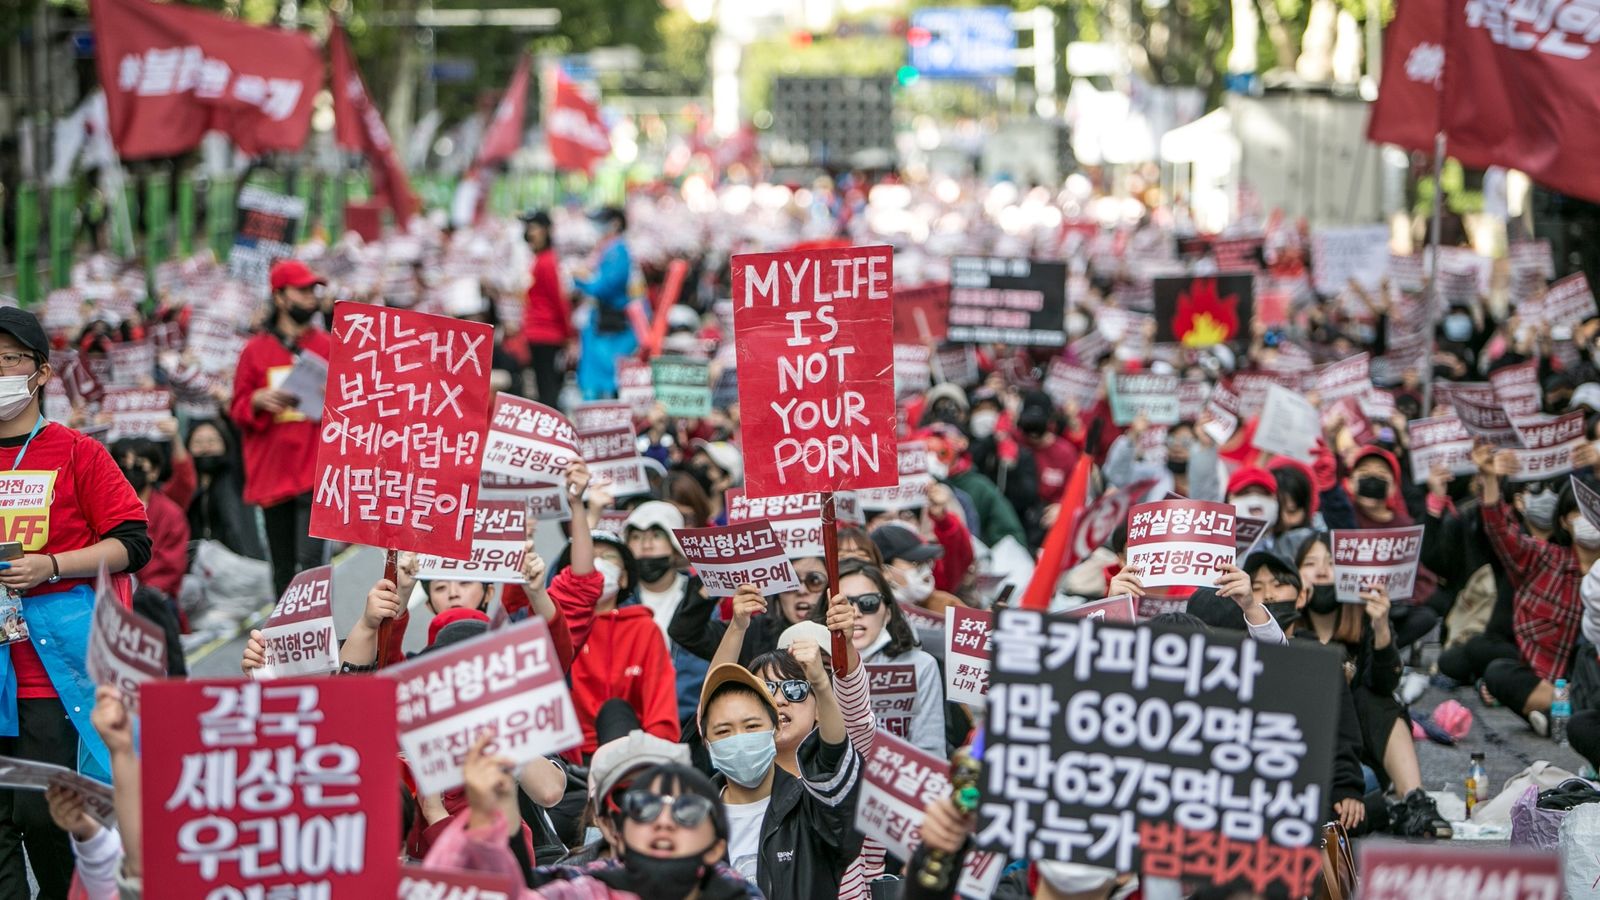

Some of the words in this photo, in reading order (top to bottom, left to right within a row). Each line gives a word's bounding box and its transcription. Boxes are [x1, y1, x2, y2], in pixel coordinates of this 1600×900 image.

[785, 305, 838, 346] IS
[777, 346, 855, 394] NOT
[516, 407, 580, 450] 실형선
[771, 391, 870, 435] YOUR
[510, 446, 569, 476] 집행유
[774, 432, 879, 484] PORN
[25, 484, 44, 494] 073
[699, 528, 776, 558] 실형선고
[1150, 508, 1234, 537] 실형선고
[1356, 535, 1420, 562] 실형선고
[717, 561, 792, 590] 집행유예
[272, 627, 331, 664] 집행유예
[954, 632, 981, 650] 라서
[993, 610, 1264, 701] 몰카피의자
[426, 637, 551, 714] 실형선고
[953, 677, 977, 693] 니까
[198, 682, 325, 748] 결국
[165, 743, 361, 812] 세상은
[177, 811, 368, 881] 우리에
